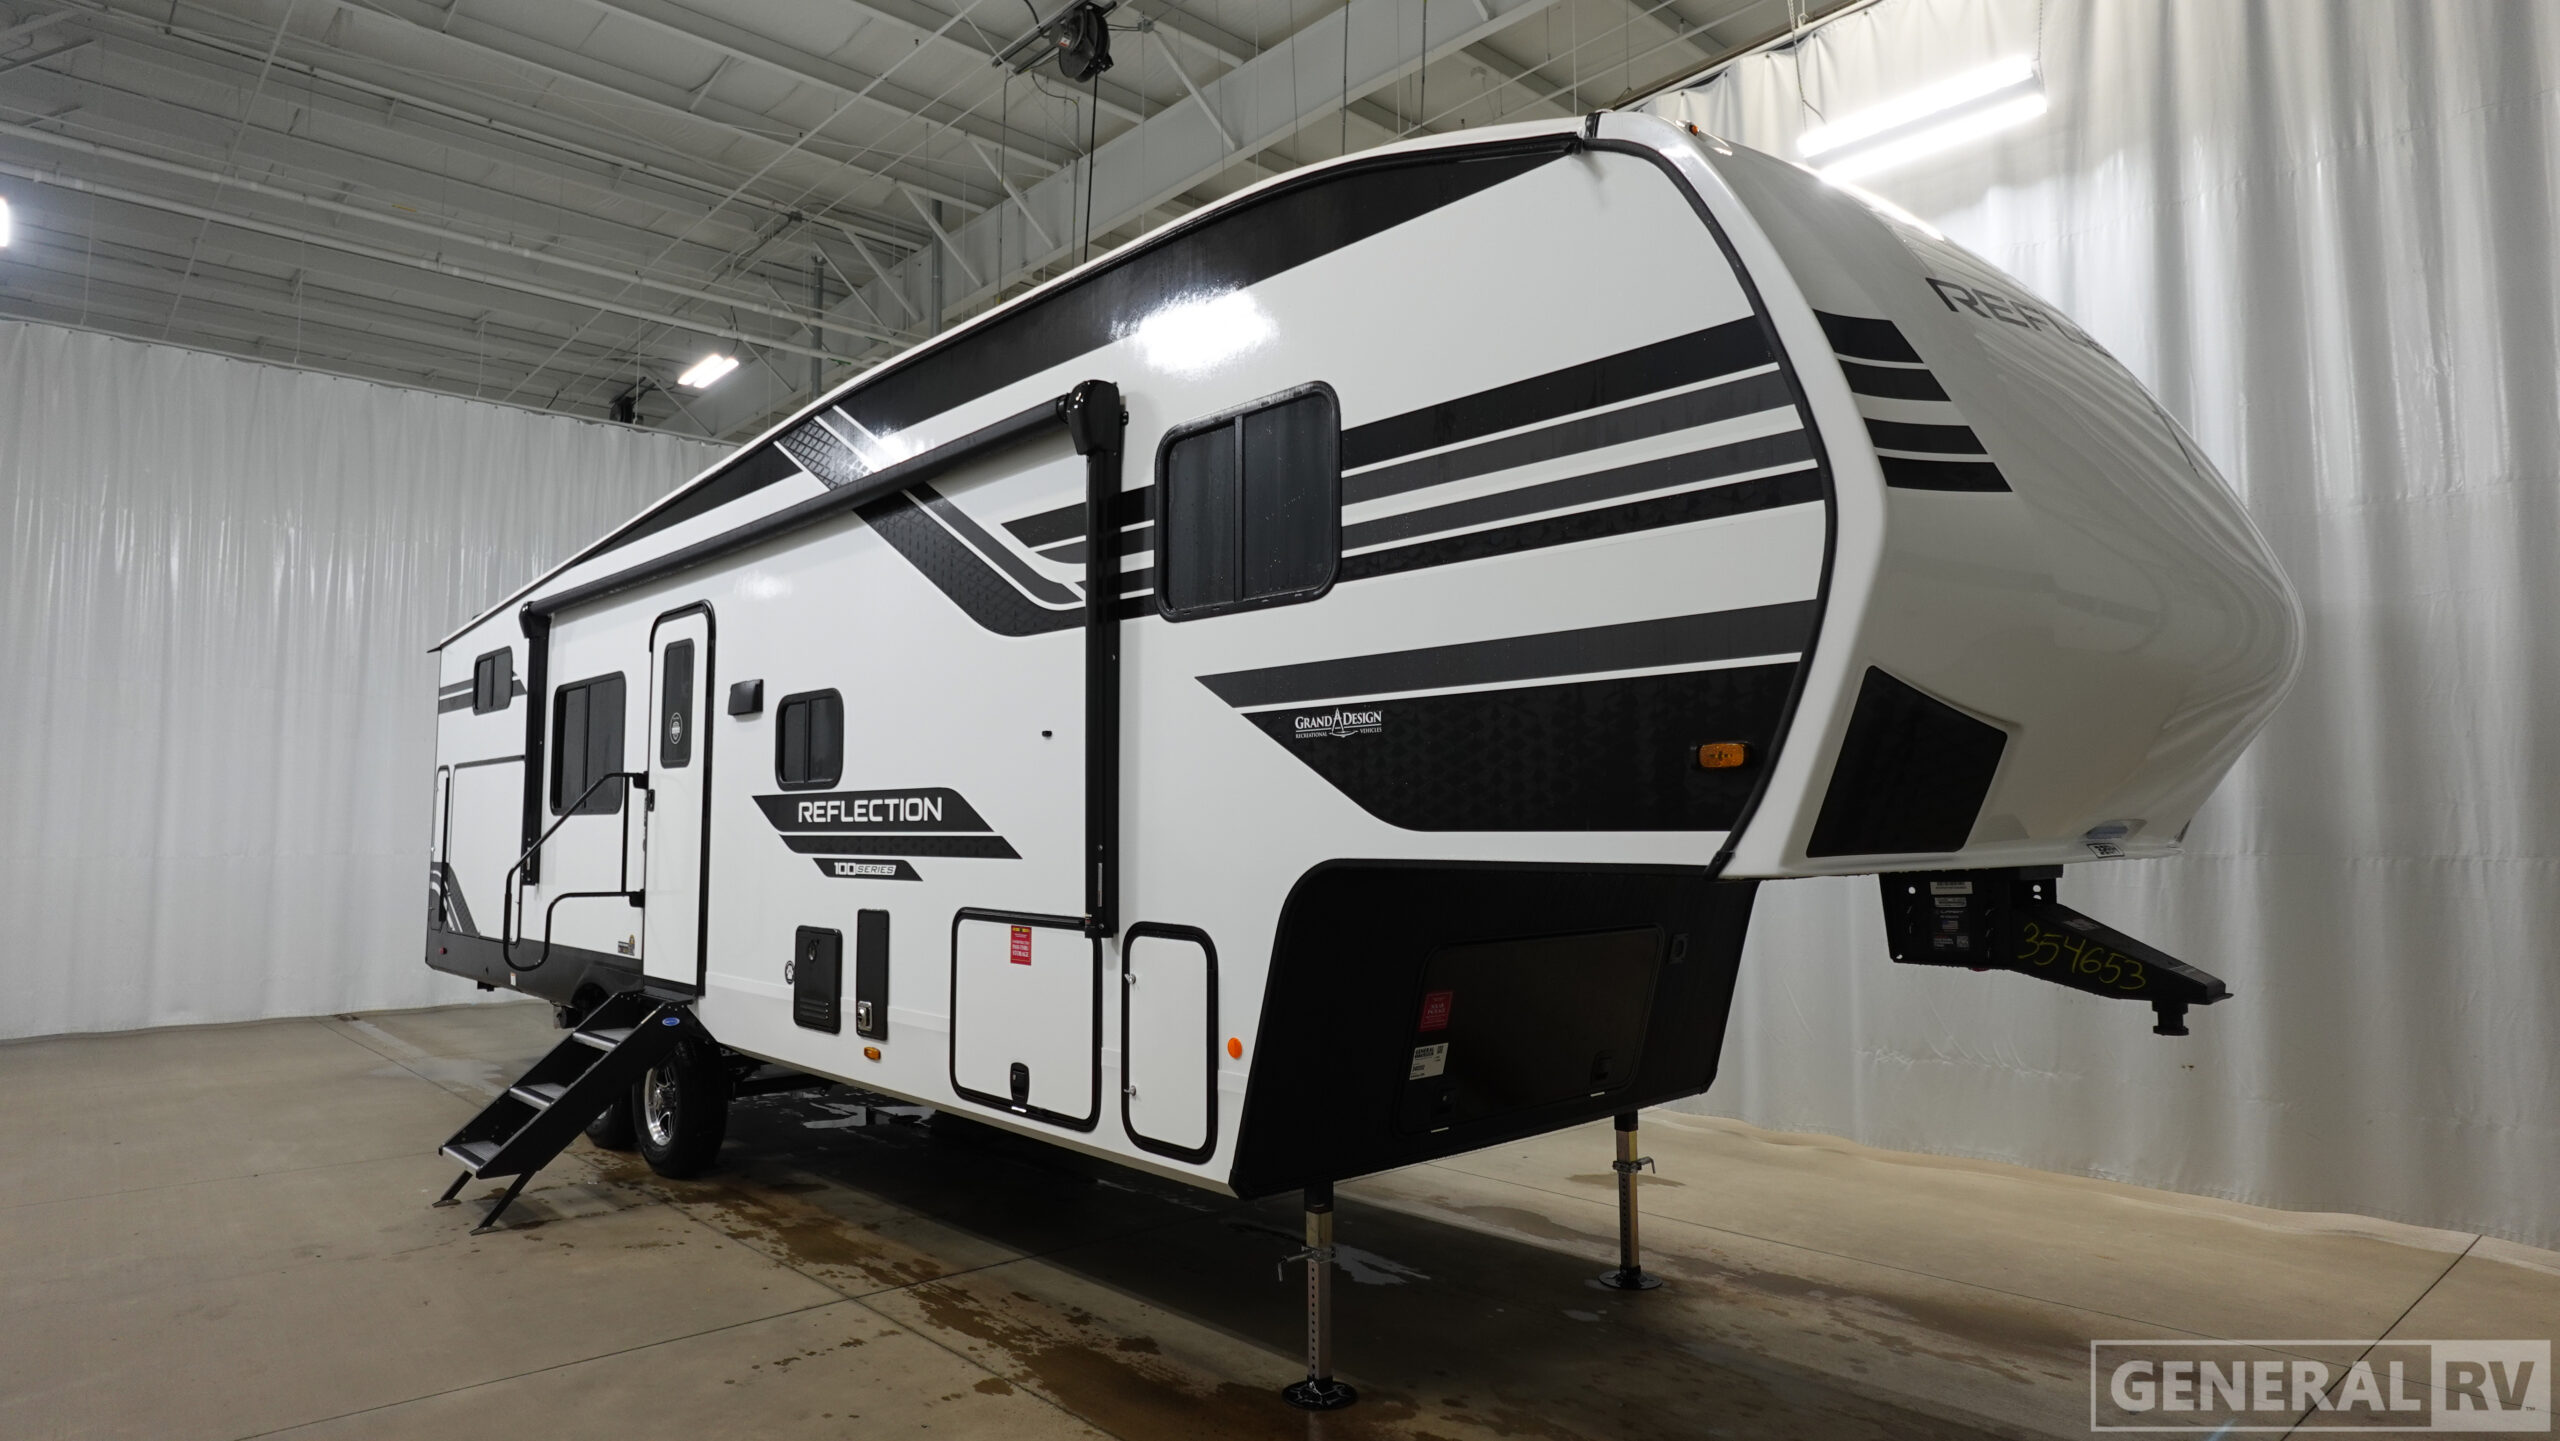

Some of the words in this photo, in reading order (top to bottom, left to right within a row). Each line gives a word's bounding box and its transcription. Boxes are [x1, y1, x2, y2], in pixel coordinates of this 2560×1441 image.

[1295, 715, 1333, 730] GRAND
[1343, 710, 1382, 725] DESIGN
[1295, 731, 1328, 739] RECREATIONAL
[798, 797, 942, 823] REFLECTION
[834, 862, 856, 876] 100
[857, 865, 895, 875] SERIES
[2018, 922, 2147, 990] 354653
